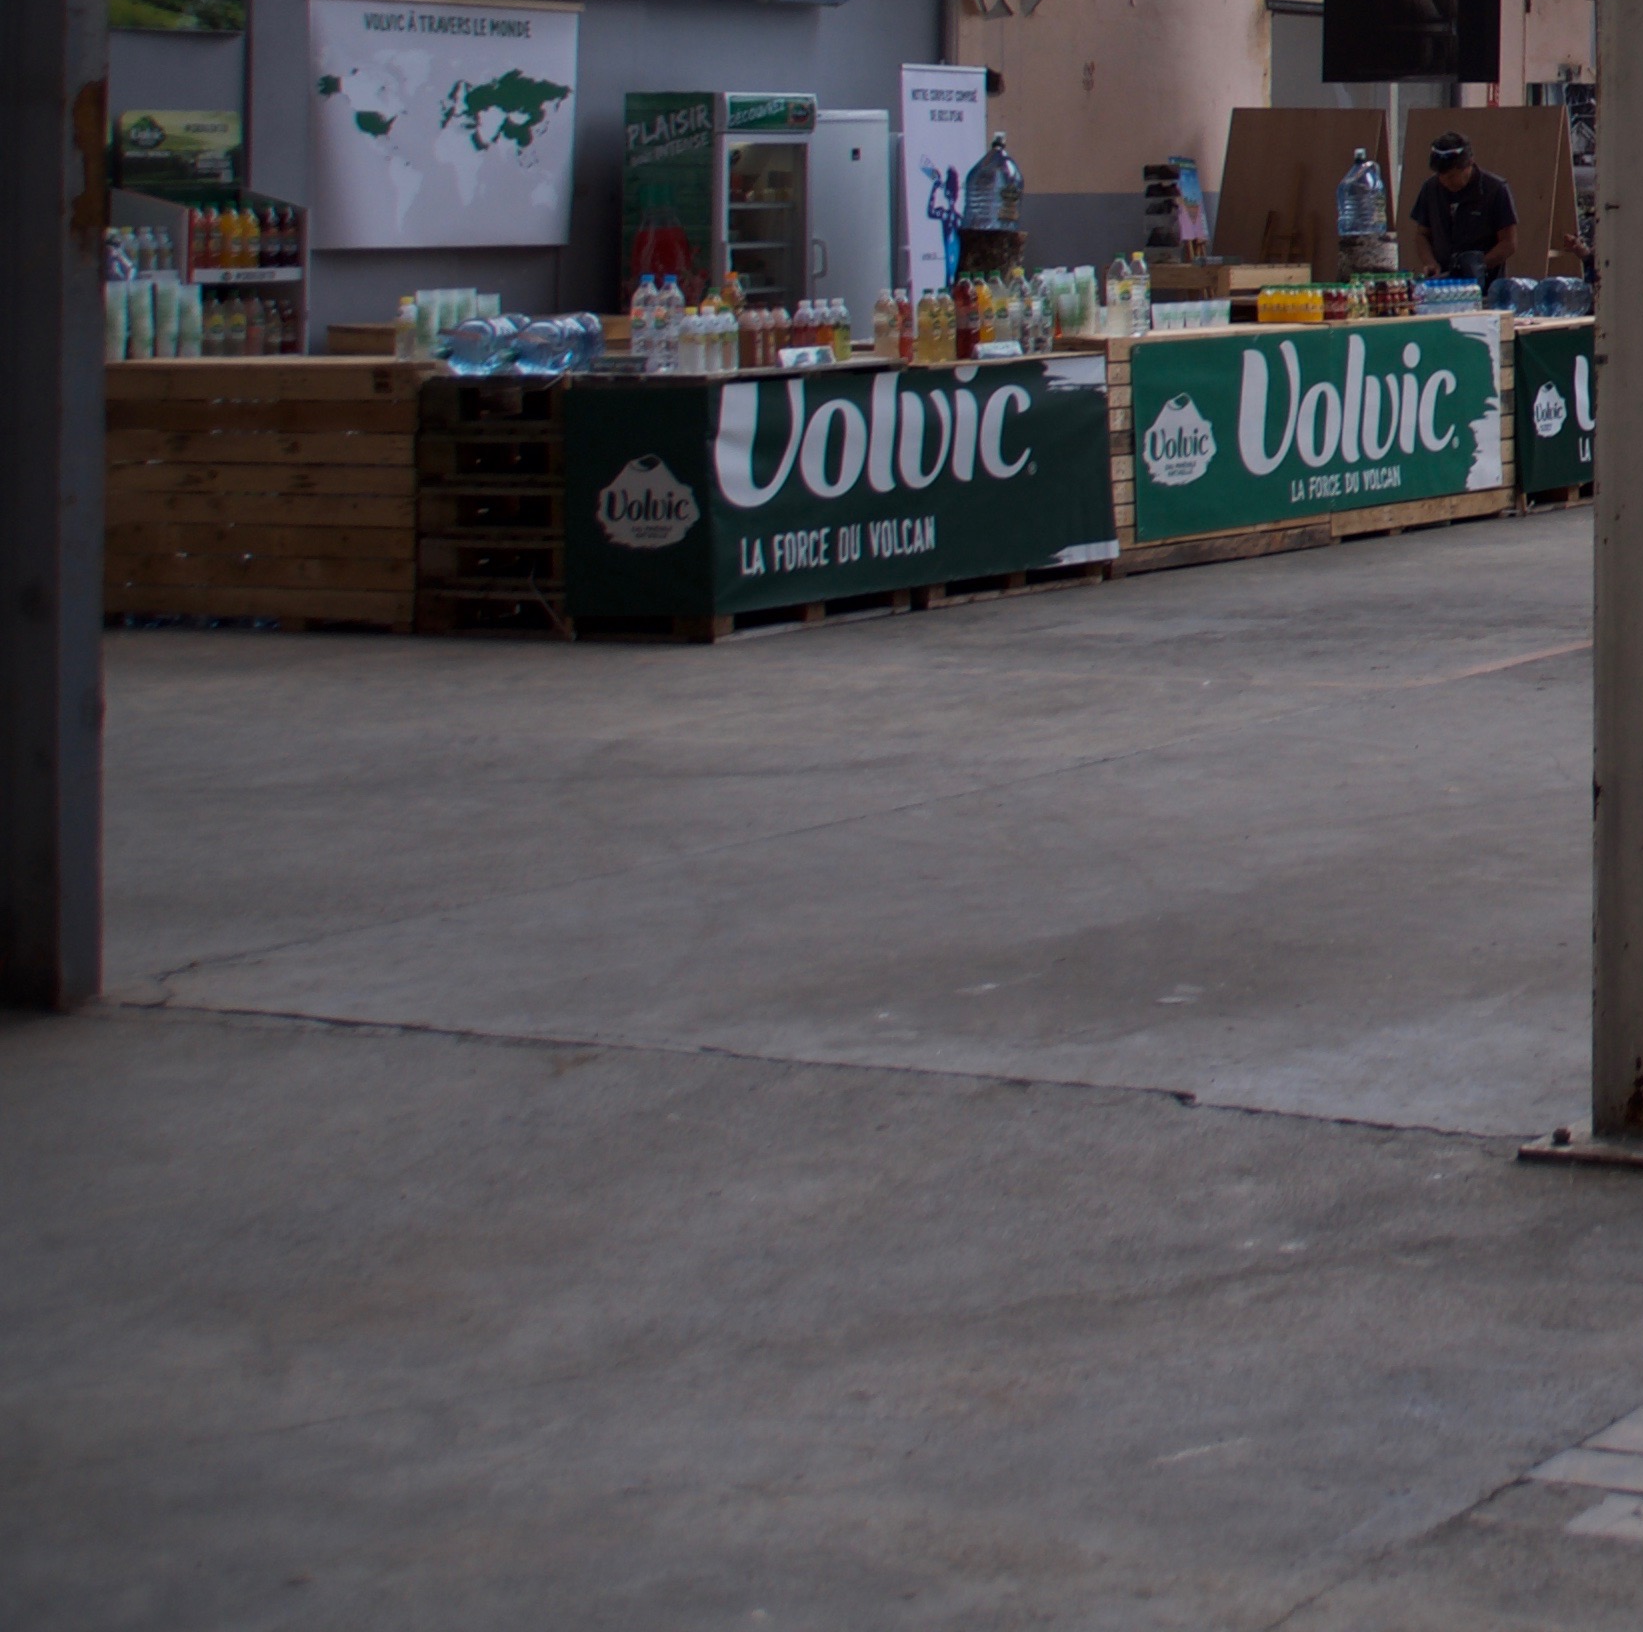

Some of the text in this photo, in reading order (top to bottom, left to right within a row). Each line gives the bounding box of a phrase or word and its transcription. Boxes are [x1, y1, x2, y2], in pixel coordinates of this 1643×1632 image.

[364, 10, 532, 39] VOLVIC À TRAVERS LE MONDE
[627, 104, 713, 150] PLAISIR
[1238, 333, 1458, 477] Volvic
[714, 366, 1033, 508] Volvic
[1150, 425, 1209, 461] Volvic
[1290, 464, 1401, 503] LA FORCE DU VOLCAN
[607, 488, 690, 523] Volvic
[740, 515, 937, 577] LA FORCE DU VOLCAN
